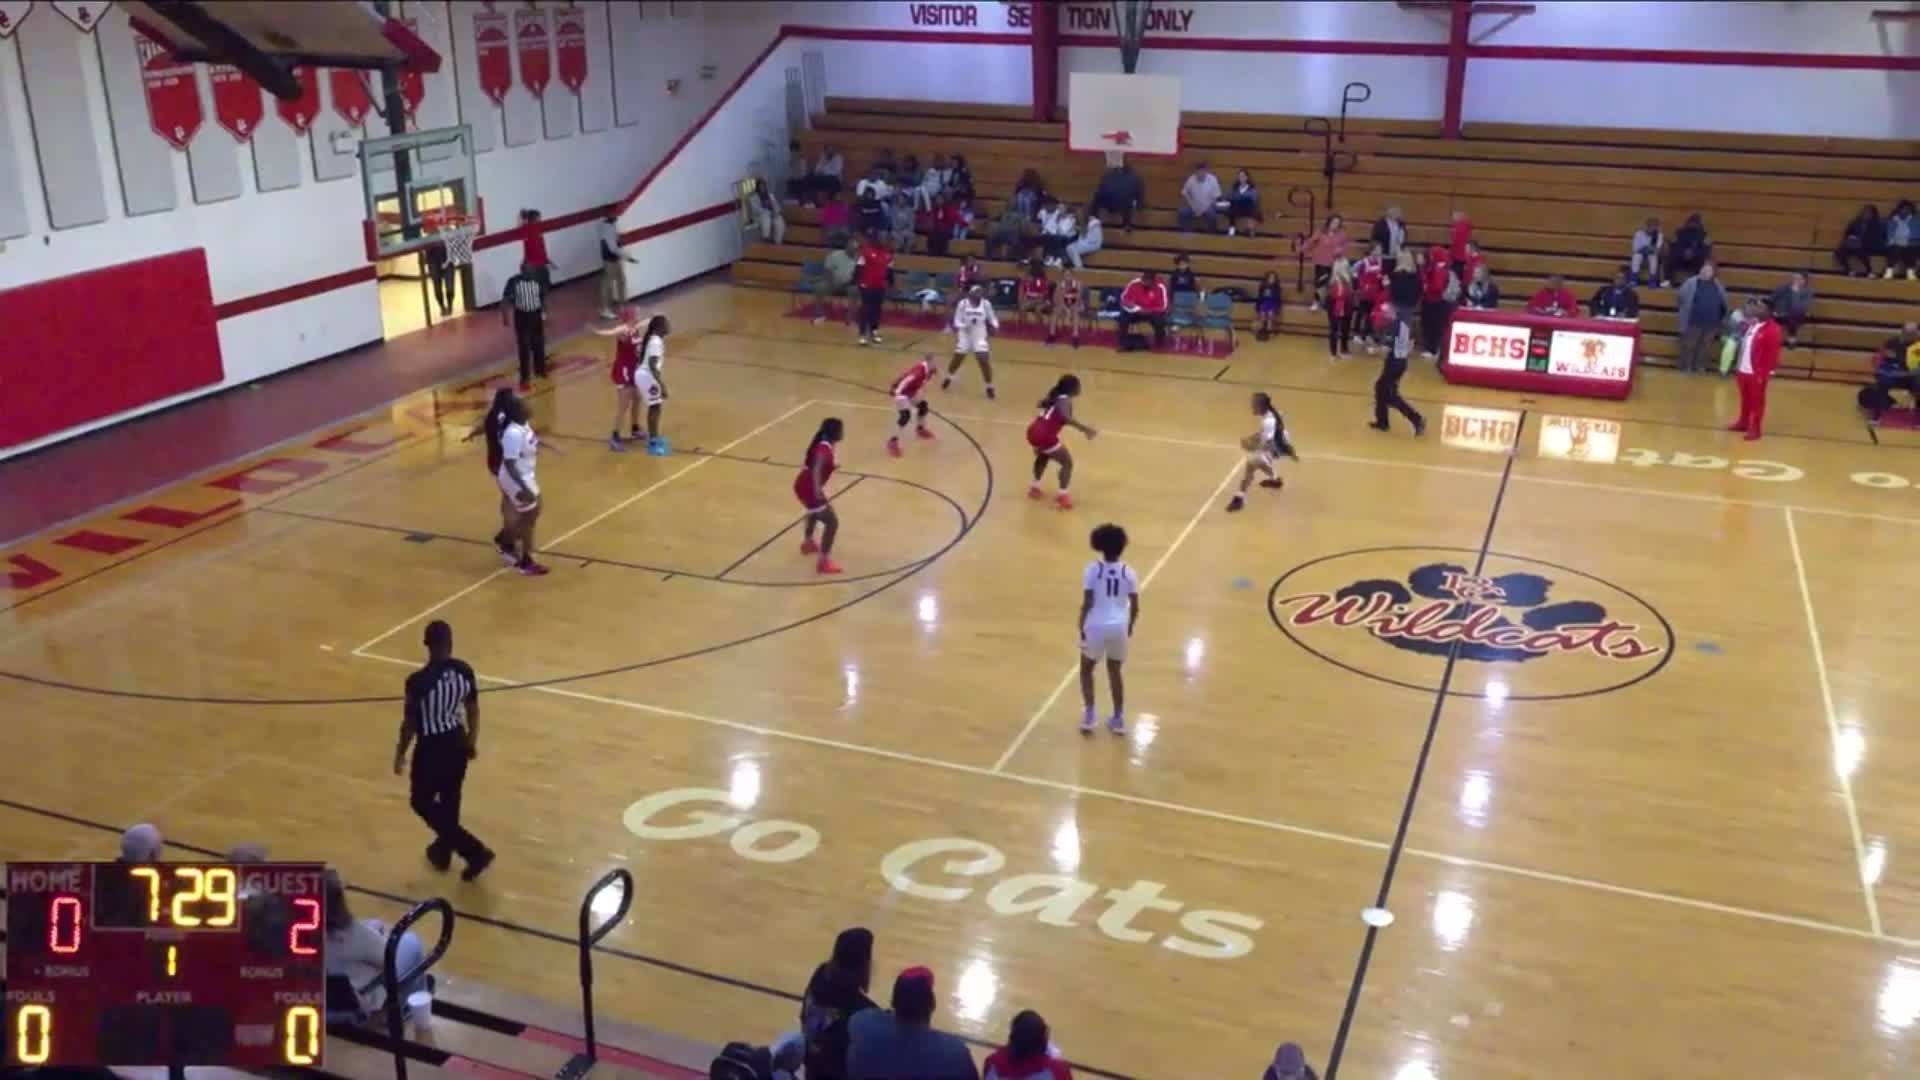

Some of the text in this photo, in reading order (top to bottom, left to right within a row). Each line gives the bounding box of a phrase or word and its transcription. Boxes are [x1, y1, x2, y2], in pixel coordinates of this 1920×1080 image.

[910, 3, 1194, 32] VISITOR SETION ONLY
[1453, 333, 1526, 360] BCHS
[1106, 578, 1119, 597] 11
[1279, 592, 1661, 659] Wildcats
[623, 787, 1265, 959] Go Cats
